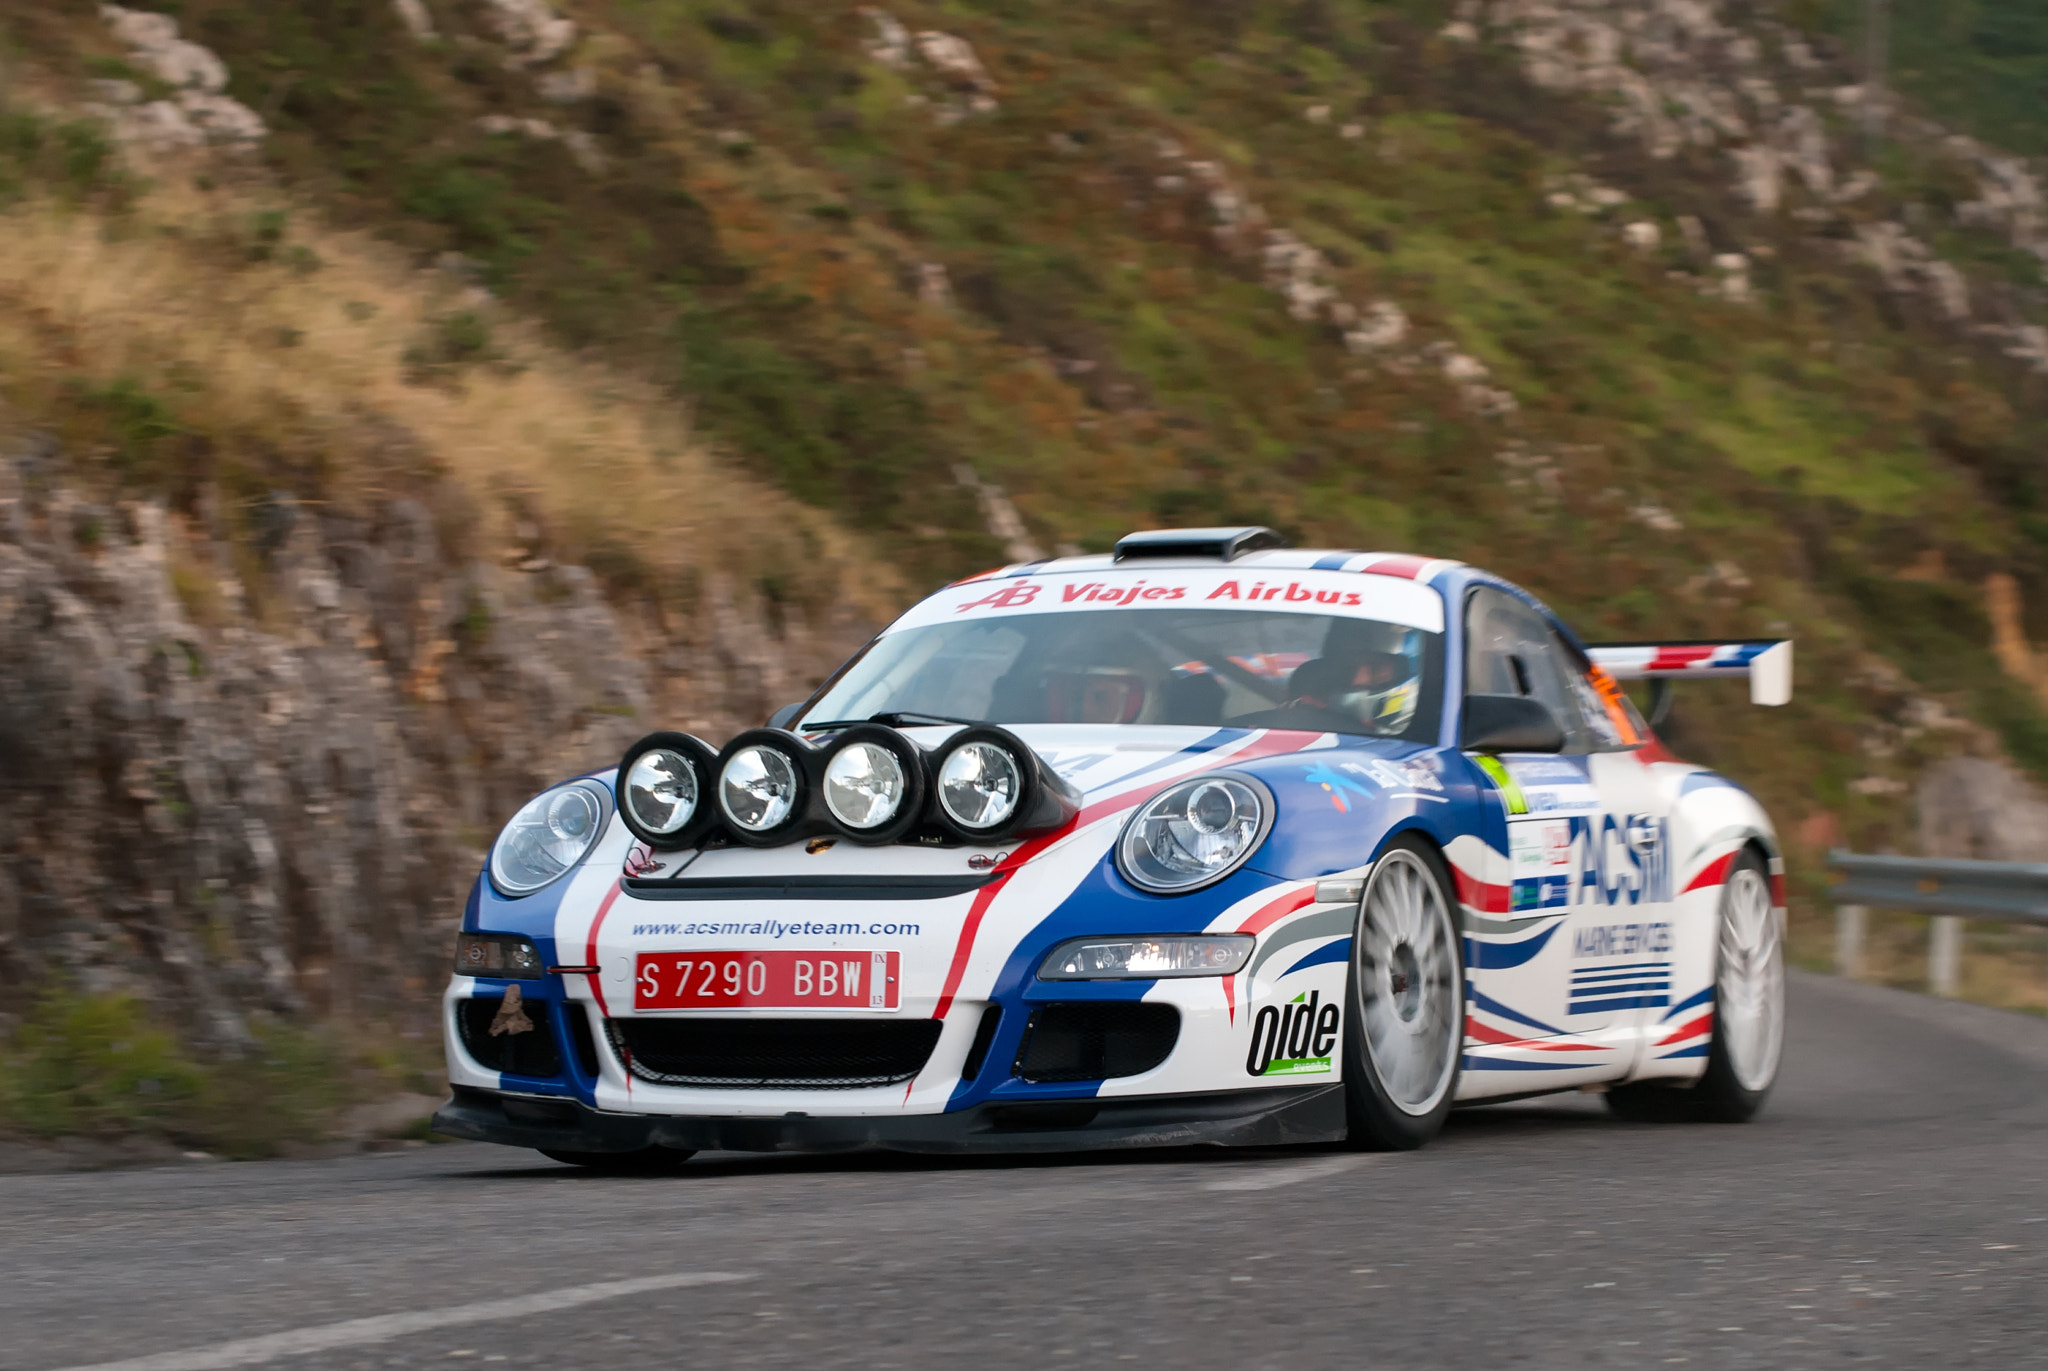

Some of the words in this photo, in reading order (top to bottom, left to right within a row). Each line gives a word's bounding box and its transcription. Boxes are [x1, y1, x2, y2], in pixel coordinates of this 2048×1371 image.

[1062, 580, 1188, 606] Viajes
[1205, 581, 1363, 606] Airbus
[632, 920, 920, 939] www.acsmrallyeteam.com
[642, 962, 660, 998] S
[676, 960, 767, 998] 7290
[793, 960, 862, 997] BBW
[872, 995, 883, 1005] 13
